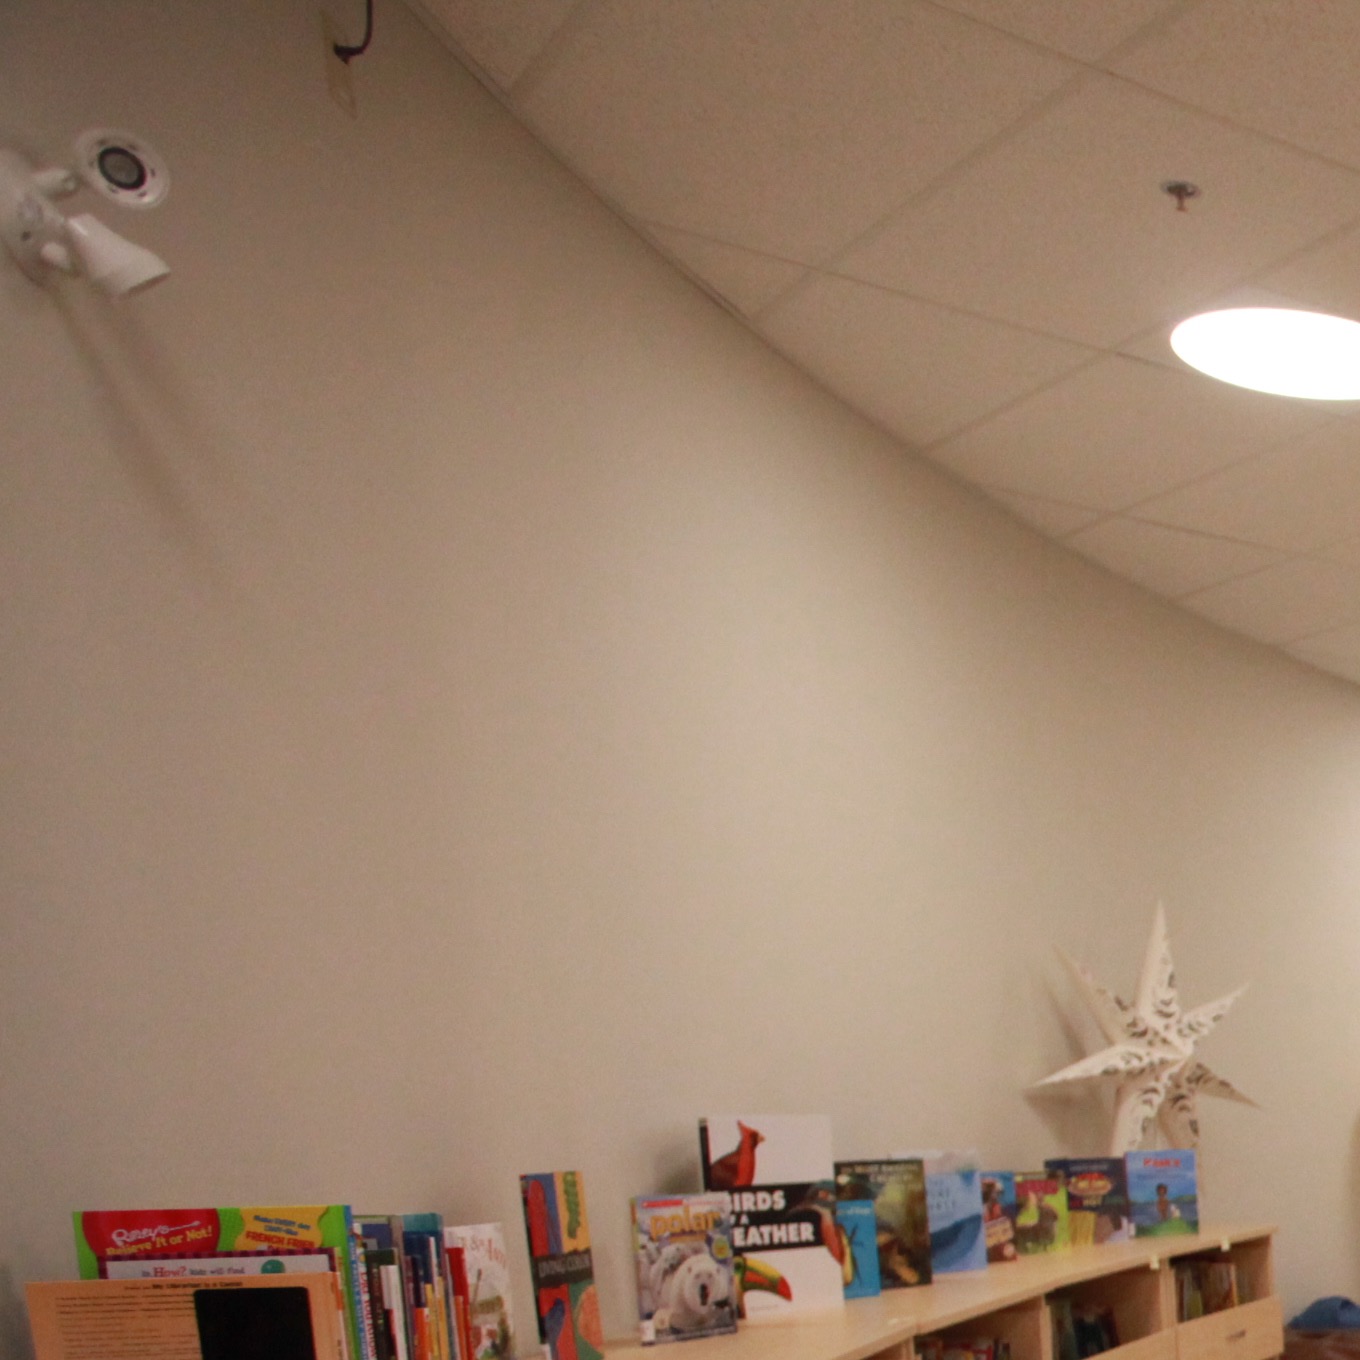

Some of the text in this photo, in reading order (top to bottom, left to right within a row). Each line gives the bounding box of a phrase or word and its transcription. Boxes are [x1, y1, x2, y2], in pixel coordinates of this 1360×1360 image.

[650, 1205, 721, 1242] polar
[733, 1222, 815, 1248] EATHER
[156, 1234, 166, 1248] It
[170, 1234, 182, 1244] or
[186, 1225, 213, 1243] Not!
[153, 1266, 186, 1277] How?
